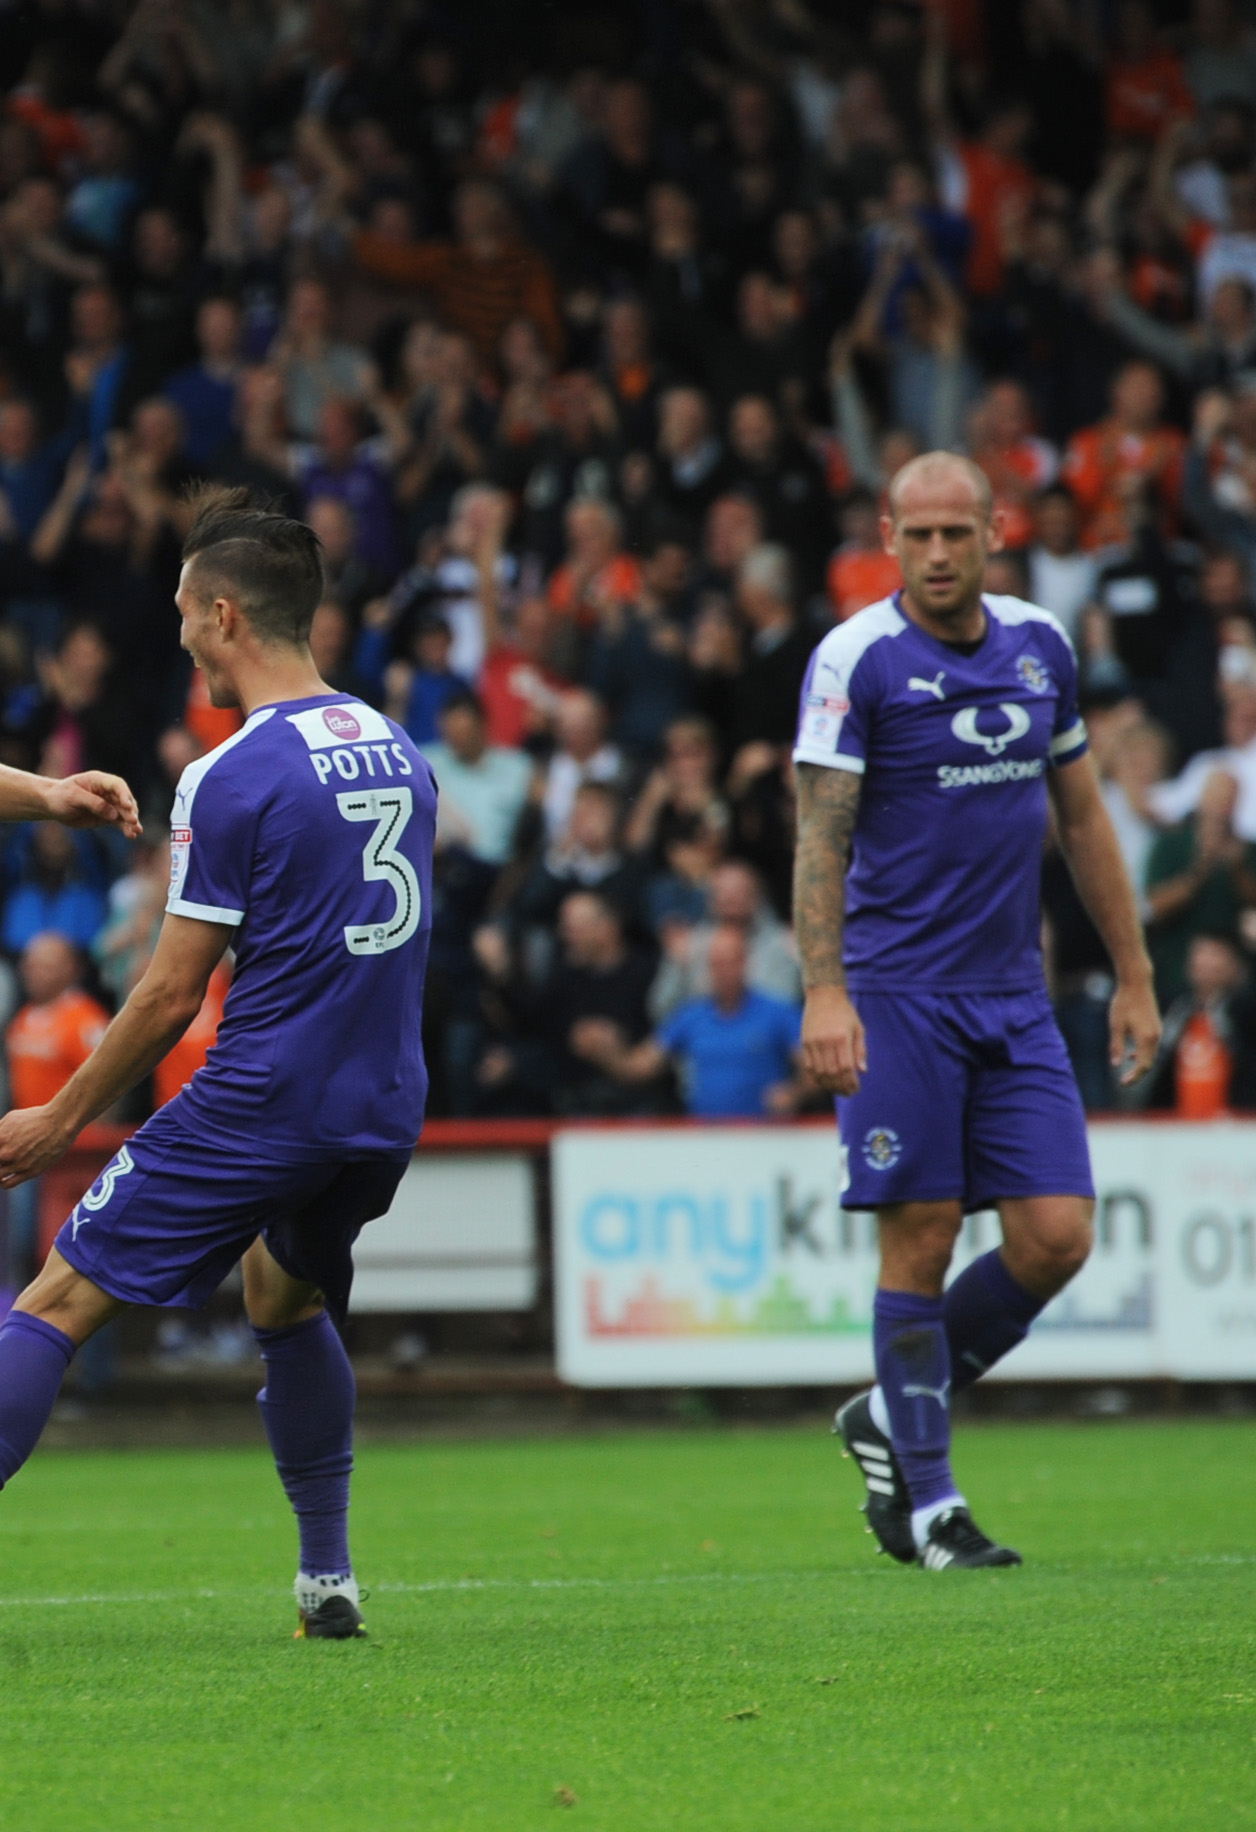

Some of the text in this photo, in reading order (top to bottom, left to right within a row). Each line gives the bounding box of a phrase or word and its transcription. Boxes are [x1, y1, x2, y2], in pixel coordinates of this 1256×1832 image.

[309, 743, 412, 785] POTTS
[937, 759, 1041, 788] SSANGYONG
[175, 831, 190, 841] BET
[335, 786, 421, 955] 3
[82, 1144, 135, 1211] 3
